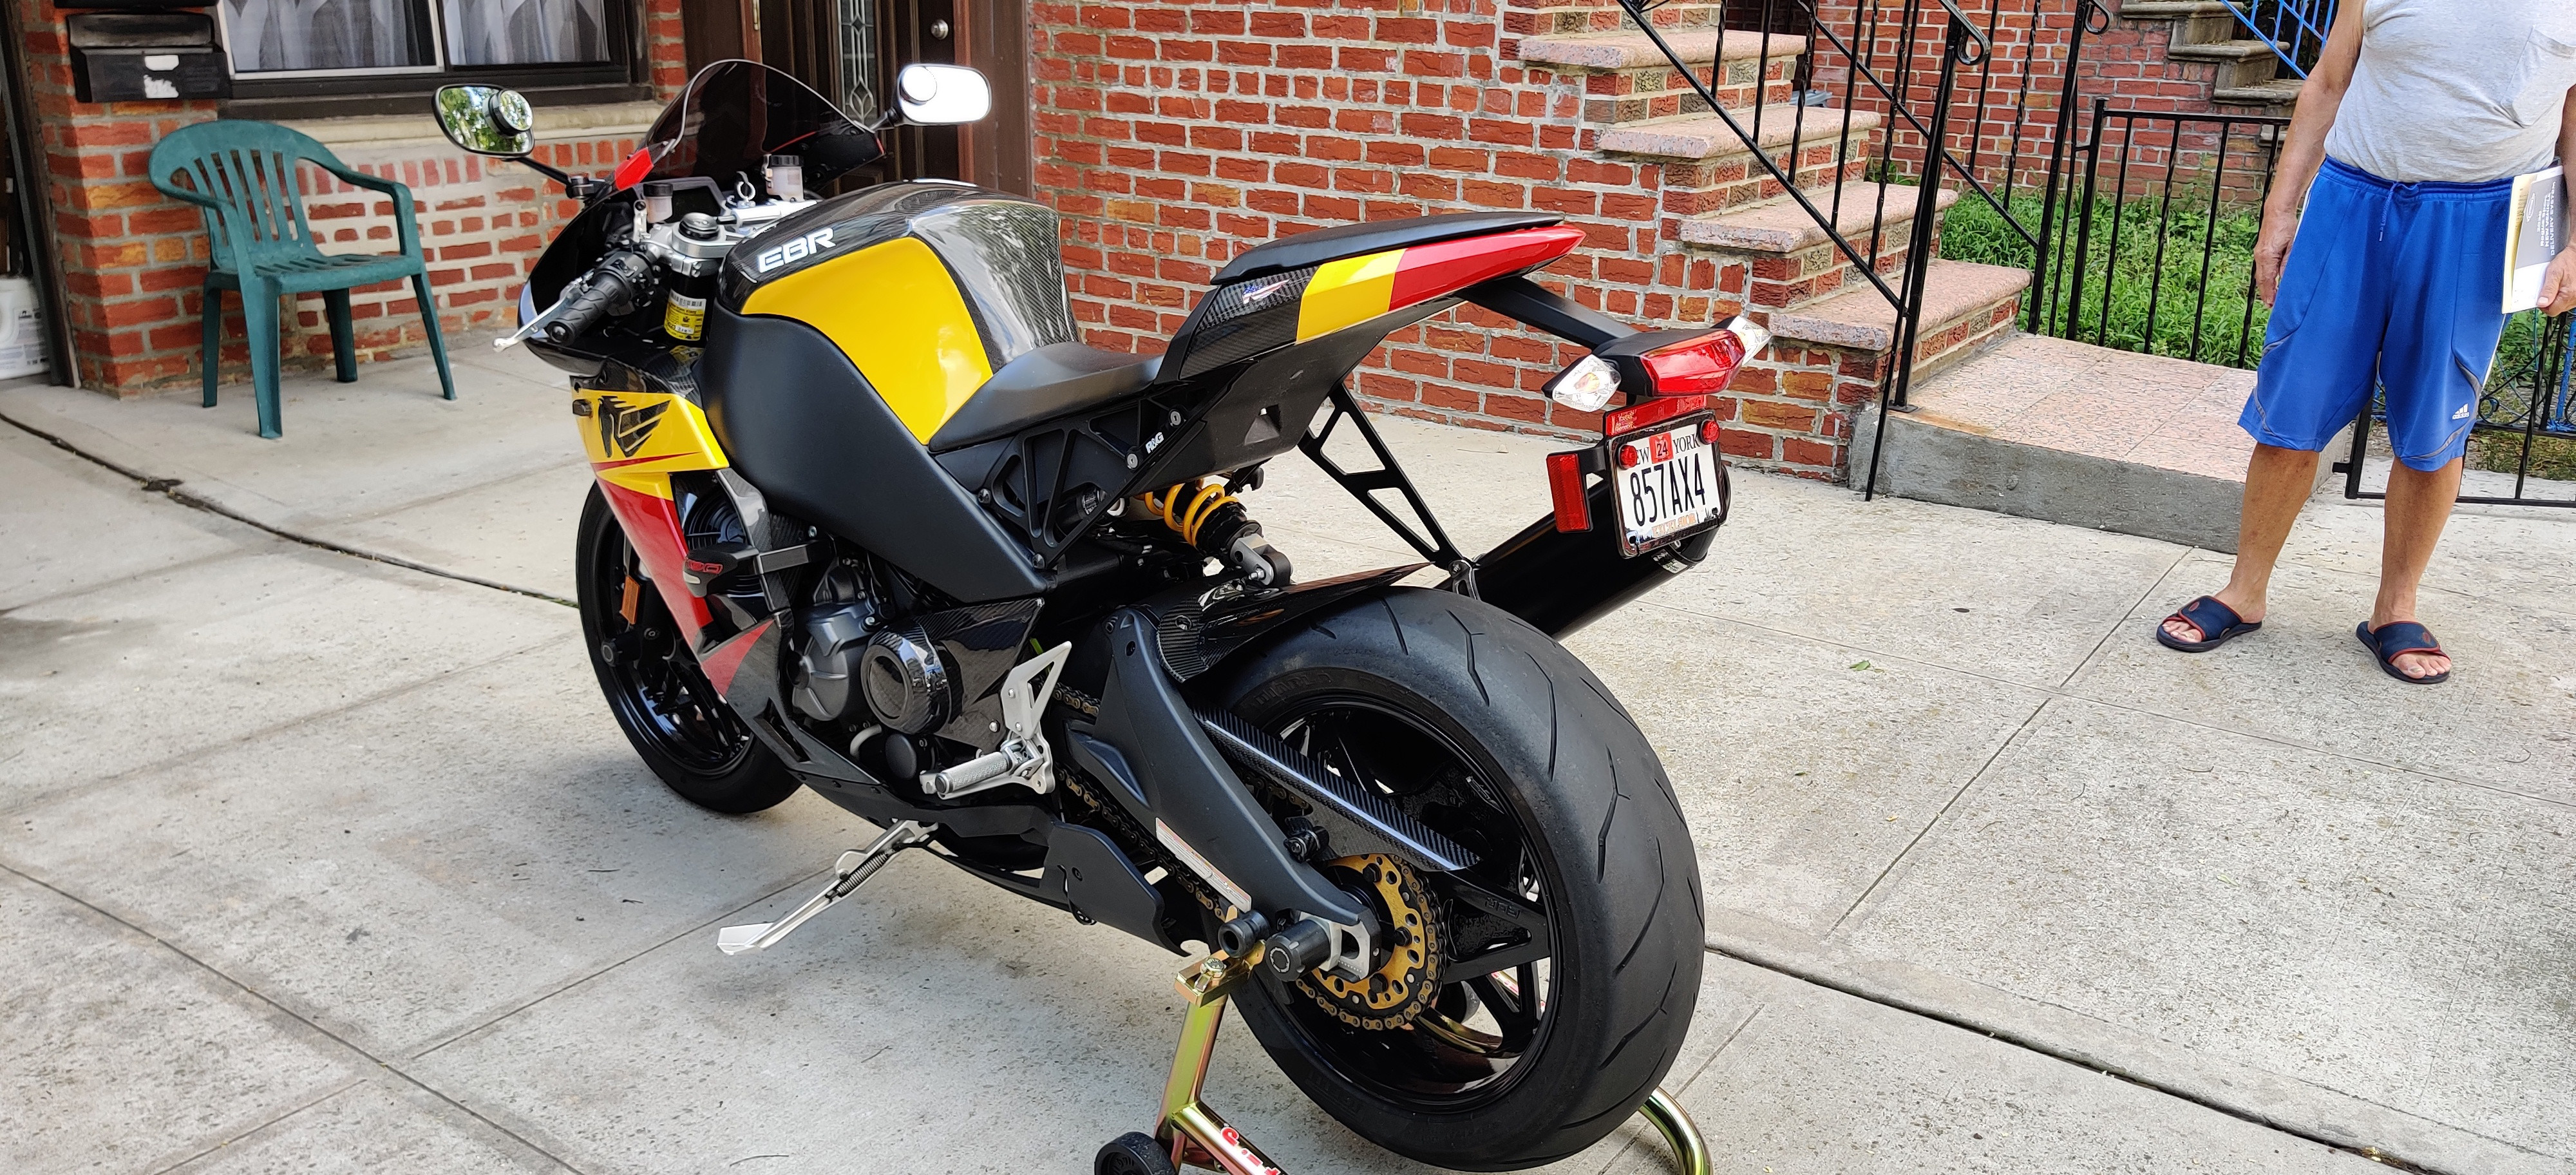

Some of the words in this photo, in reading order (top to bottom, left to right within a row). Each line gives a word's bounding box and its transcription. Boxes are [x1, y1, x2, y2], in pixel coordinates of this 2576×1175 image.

[757, 227, 837, 273] EBR
[1146, 432, 1164, 454] R&G
[1636, 446, 1649, 465] EW
[1672, 434, 1700, 454] YORK
[1657, 441, 1668, 457] 24
[1630, 453, 1705, 526] 857AX4
